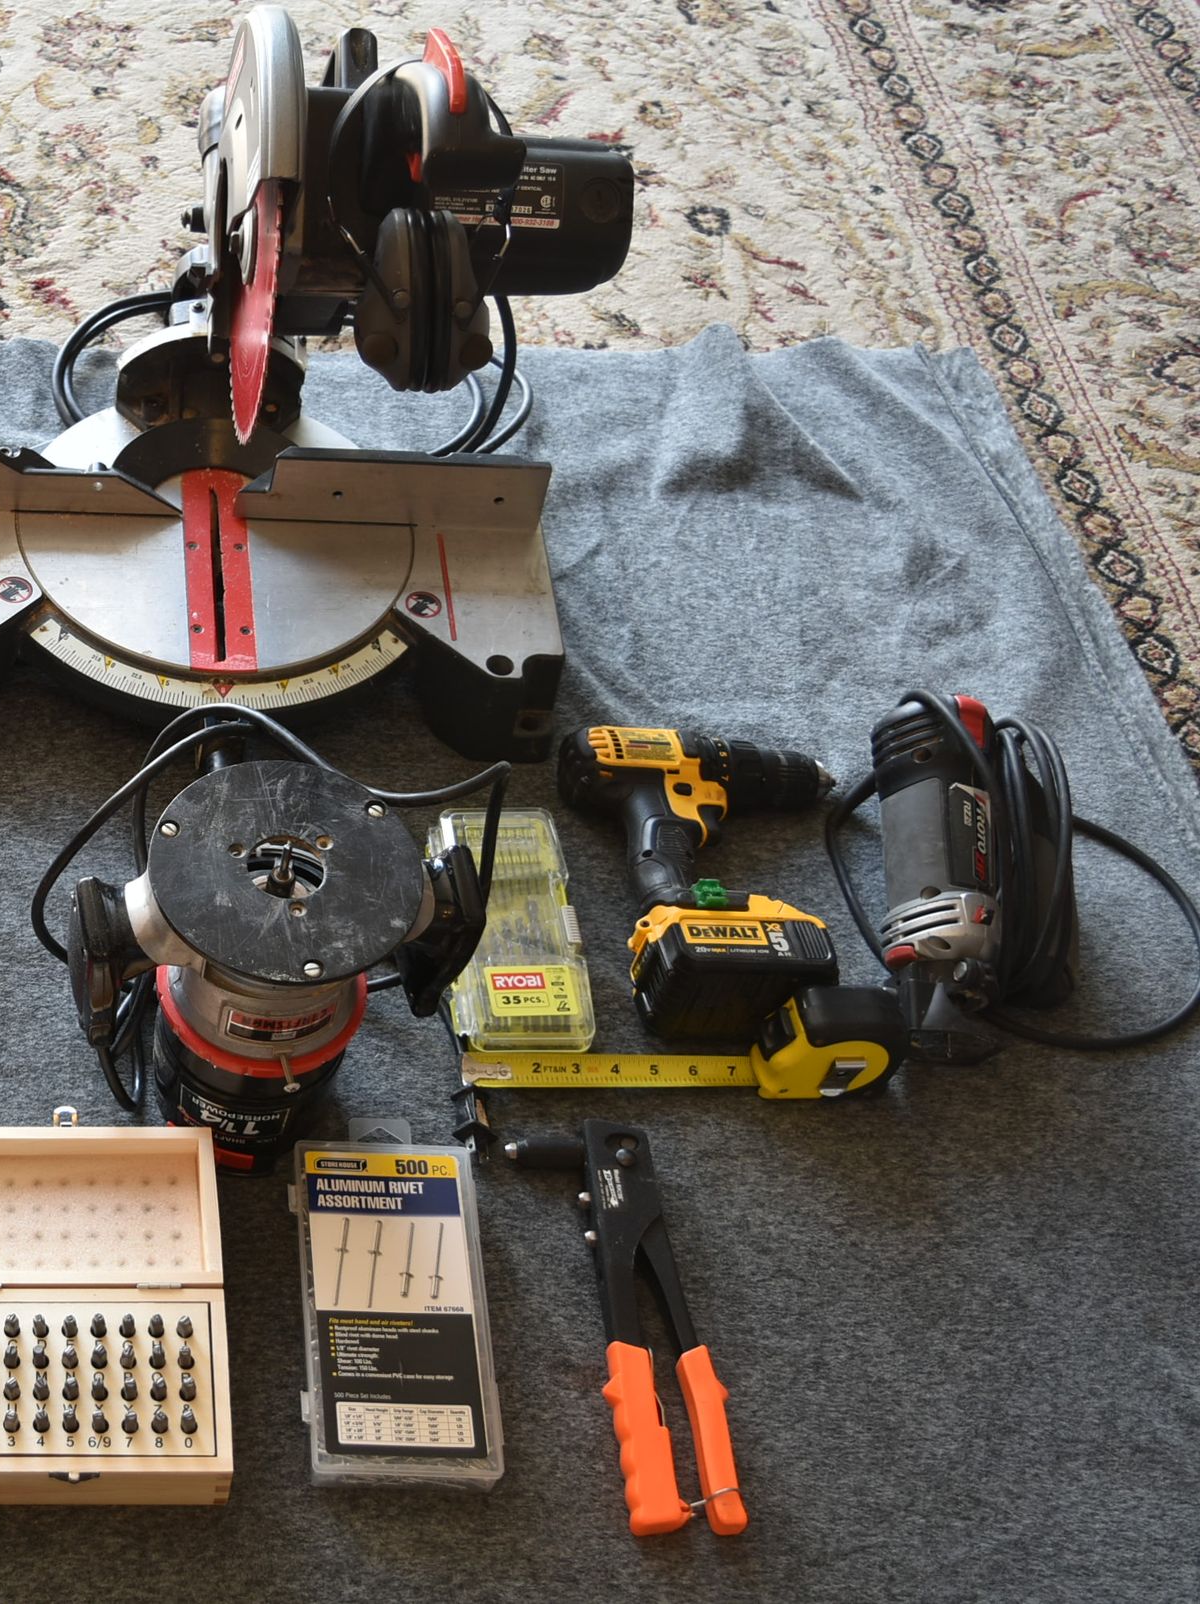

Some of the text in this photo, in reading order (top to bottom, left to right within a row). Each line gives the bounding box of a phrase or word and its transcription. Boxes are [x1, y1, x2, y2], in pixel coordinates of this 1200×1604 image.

[768, 932, 790, 952] 5
[492, 975, 543, 988] RYOBI
[502, 996, 522, 1006] 35
[532, 1062, 541, 1074] 2
[571, 1062, 580, 1074] 3
[610, 1064, 620, 1074] 4
[650, 1064, 659, 1076] 5
[688, 1064, 698, 1076] 6
[727, 1066, 736, 1077] 7
[192, 1096, 280, 1122] HORSEPOWER
[394, 1159, 429, 1176] 500
[316, 1178, 424, 1195] ALUMINUM RIVET
[317, 1194, 402, 1210] ASSORTMENT
[8, 1436, 16, 1447] 3
[36, 1436, 45, 1447] 4
[66, 1436, 74, 1447] 5
[88, 1436, 112, 1448] 6/9
[126, 1436, 133, 1448] 7
[154, 1437, 164, 1448] 8
[184, 1437, 193, 1448] 0
